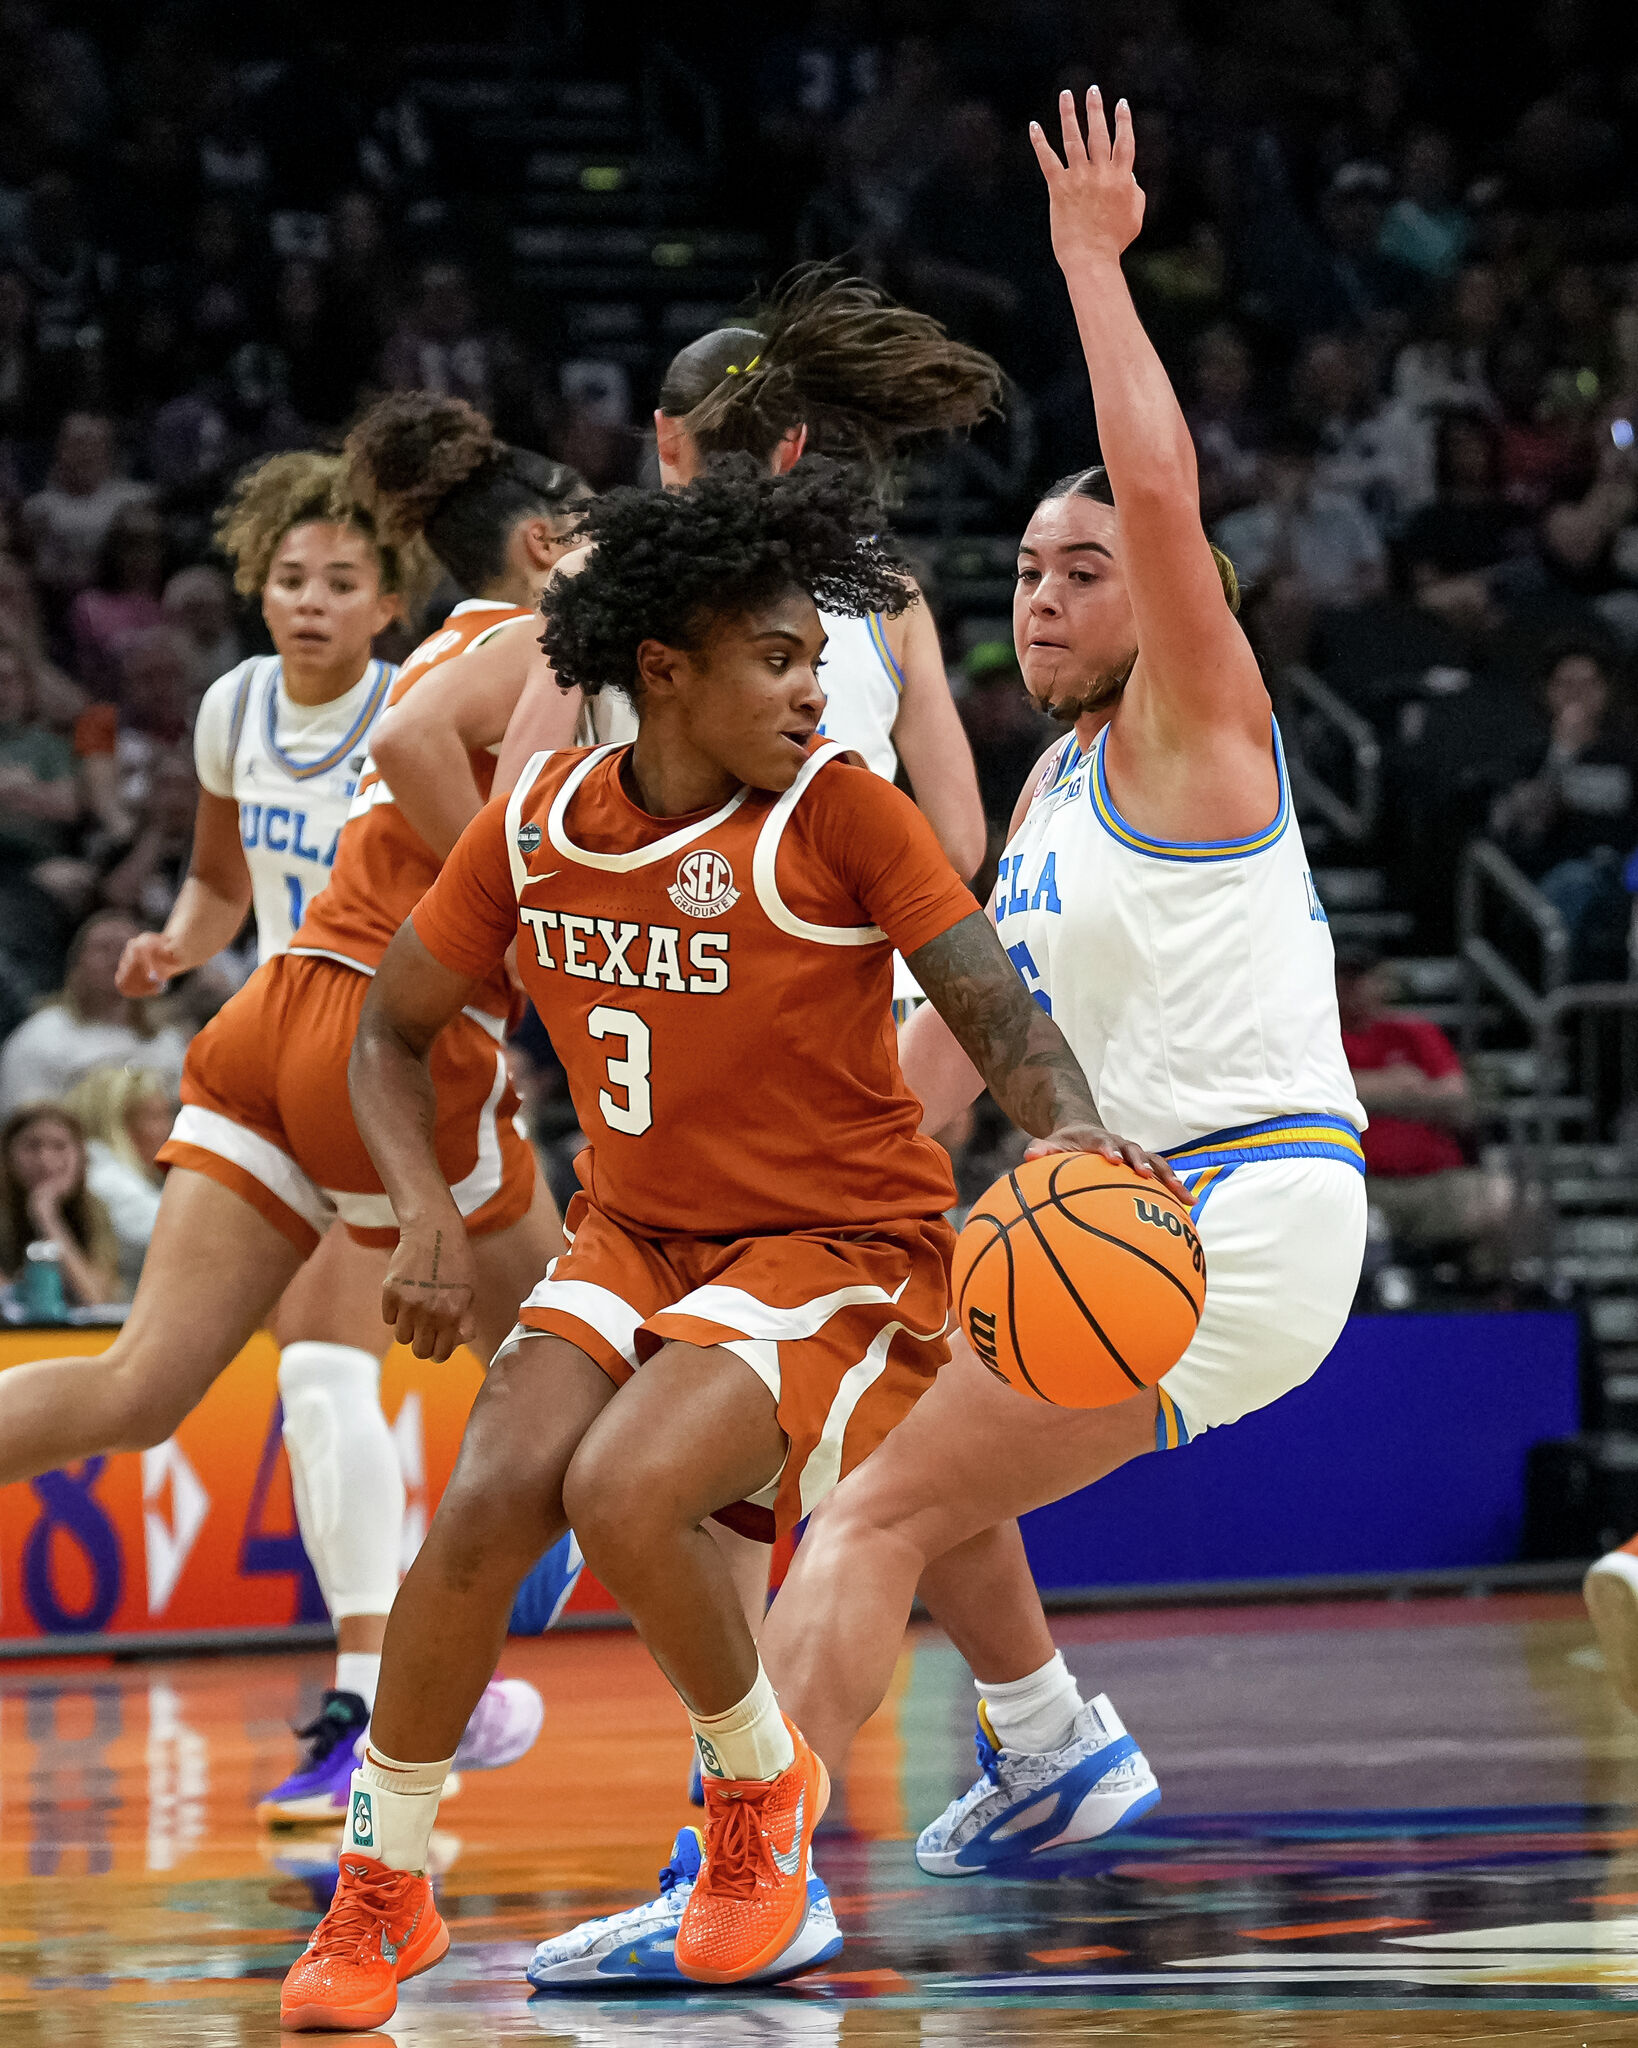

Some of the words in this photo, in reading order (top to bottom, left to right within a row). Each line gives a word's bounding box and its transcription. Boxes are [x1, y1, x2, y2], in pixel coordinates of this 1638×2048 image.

[674, 895, 731, 917] GRADUATE
[682, 854, 728, 901] SEC
[519, 906, 730, 995] TEXAS
[587, 1004, 652, 1138] 3
